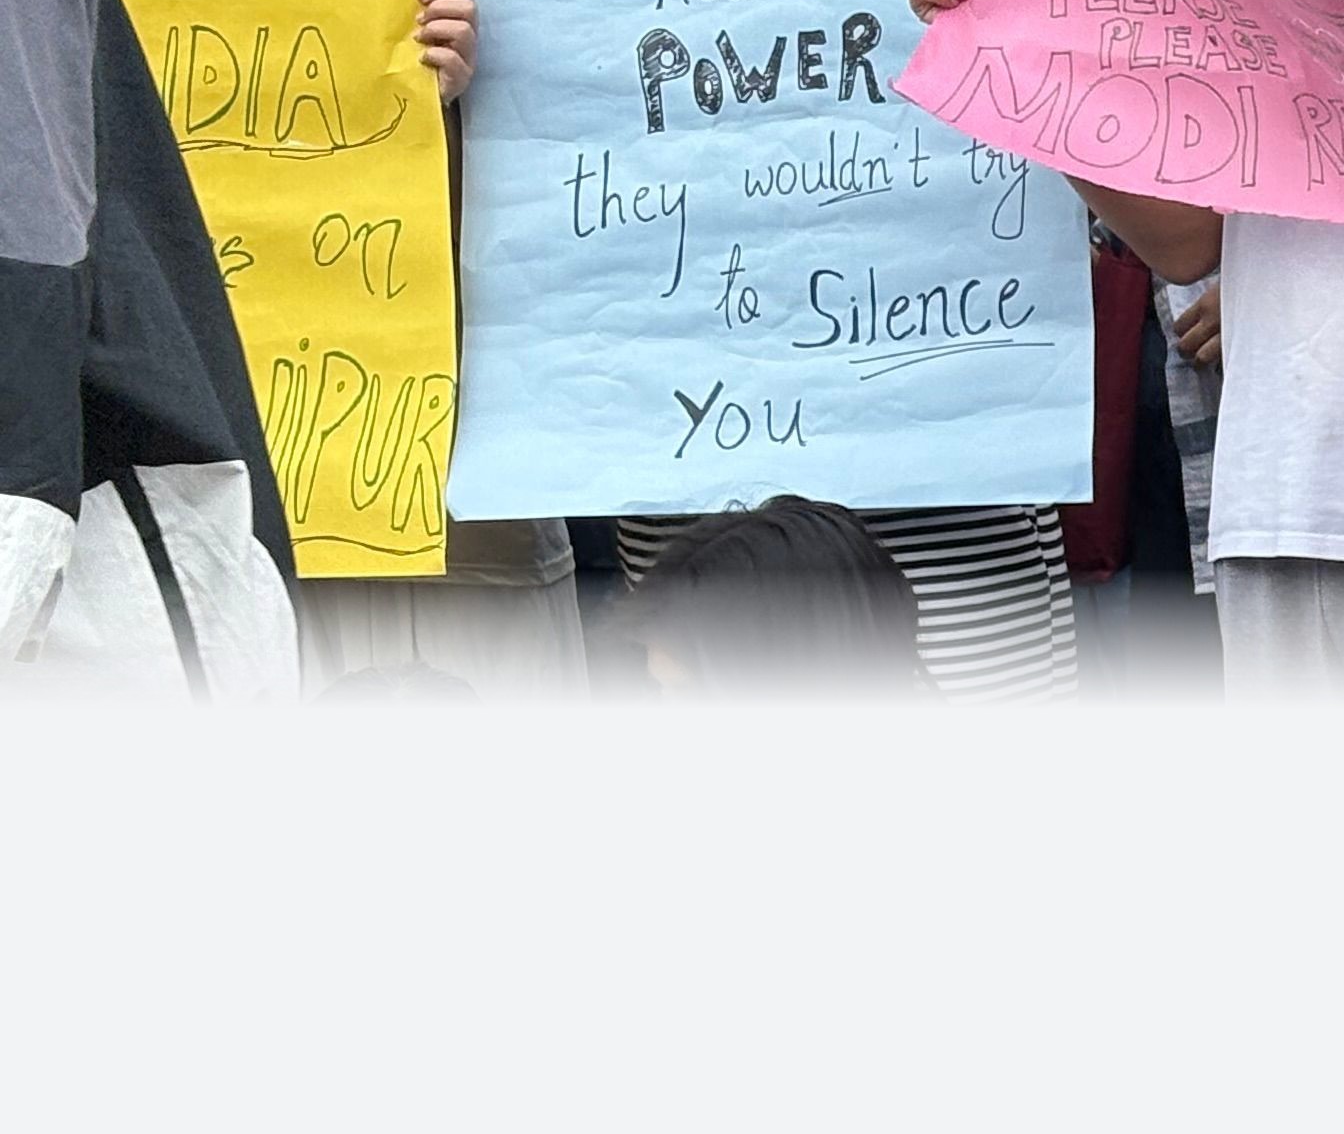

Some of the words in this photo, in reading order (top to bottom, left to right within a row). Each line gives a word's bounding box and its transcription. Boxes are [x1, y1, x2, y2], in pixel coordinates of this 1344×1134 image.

[1099, 19, 1287, 78] PLEASE
[934, 46, 1256, 187] MODI
[312, 213, 407, 299] on
[565, 150, 689, 297] they
[744, 128, 929, 199] wouldn't
[962, 137, 1030, 241] try
[715, 244, 759, 329] to
[793, 268, 1035, 348] Silence
